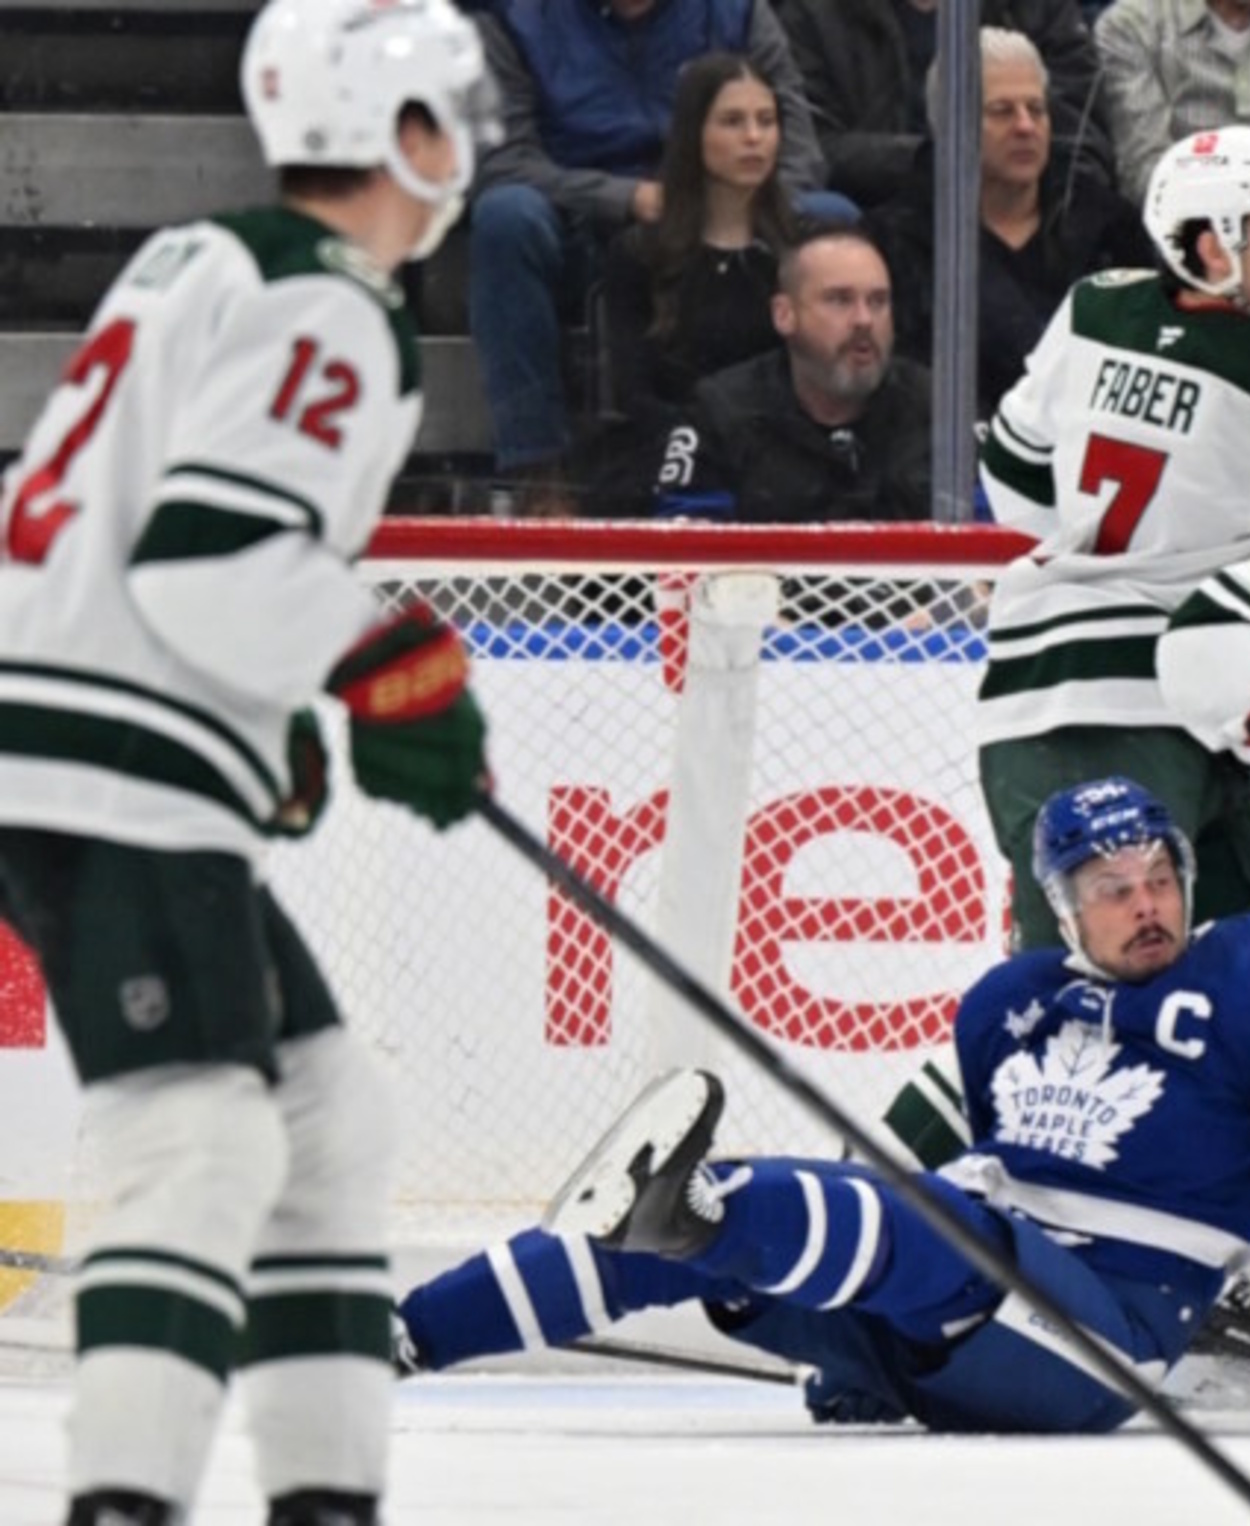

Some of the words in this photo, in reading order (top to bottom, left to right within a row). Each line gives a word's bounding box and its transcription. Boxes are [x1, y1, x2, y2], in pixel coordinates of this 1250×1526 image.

[269, 335, 363, 451] 12
[1090, 357, 1203, 436] FABER
[1079, 430, 1170, 558] 7
[1155, 990, 1213, 1060] C
[1011, 1084, 1118, 1126] TORONTO
[1020, 1110, 1093, 1138] MAPLE
